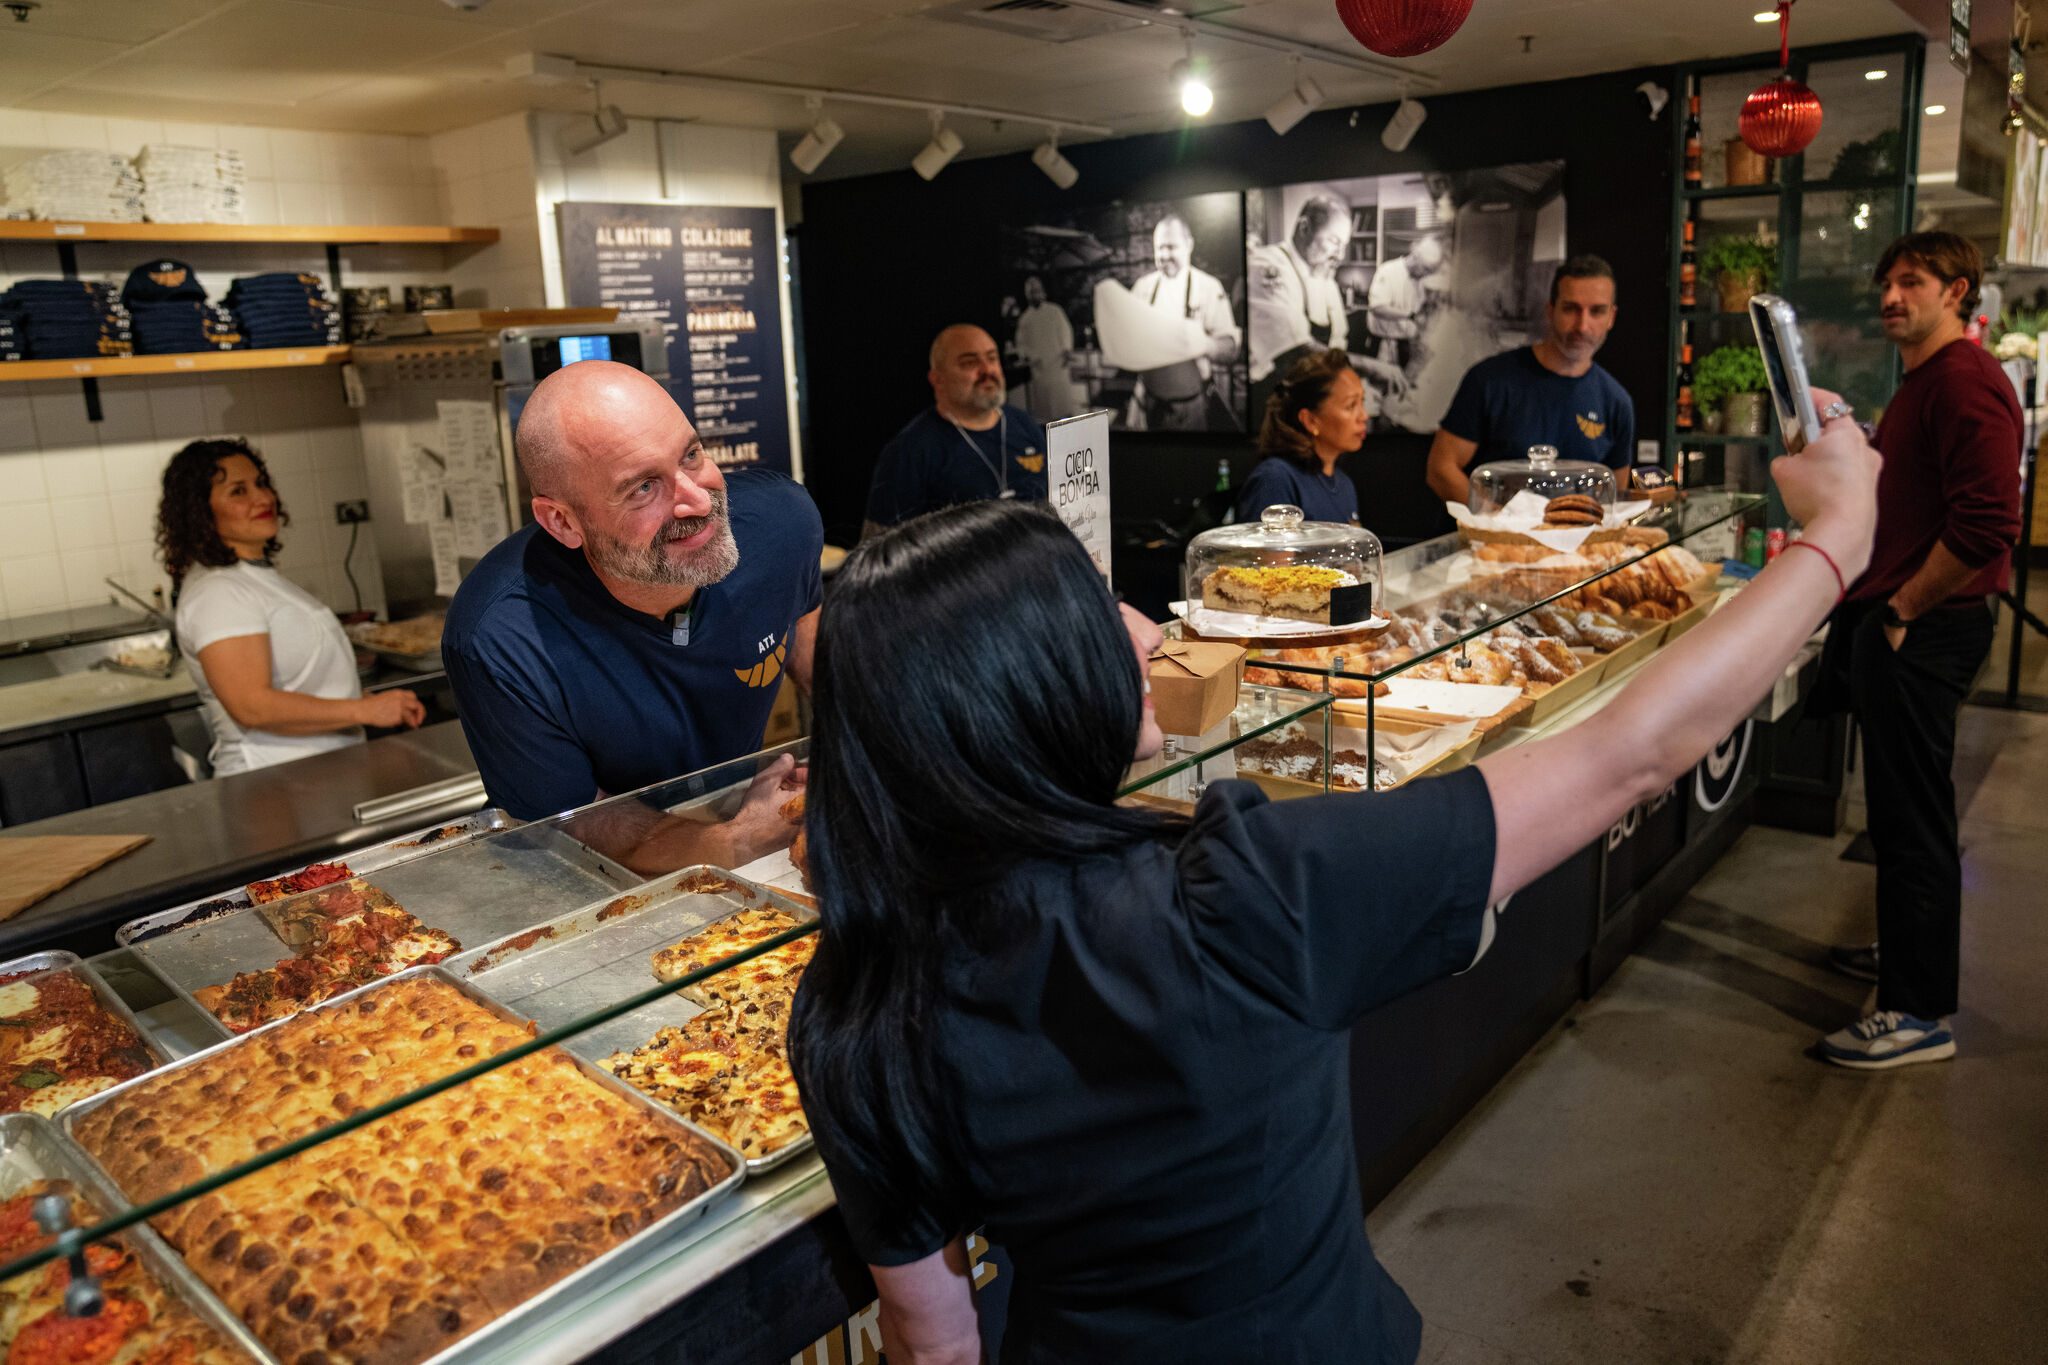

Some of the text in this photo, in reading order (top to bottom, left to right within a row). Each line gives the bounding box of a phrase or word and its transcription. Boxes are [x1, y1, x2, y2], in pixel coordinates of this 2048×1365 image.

[681, 227, 752, 247] COLAZIONE
[1059, 471, 1100, 507] BOMBA
[759, 633, 775, 654] ATX
